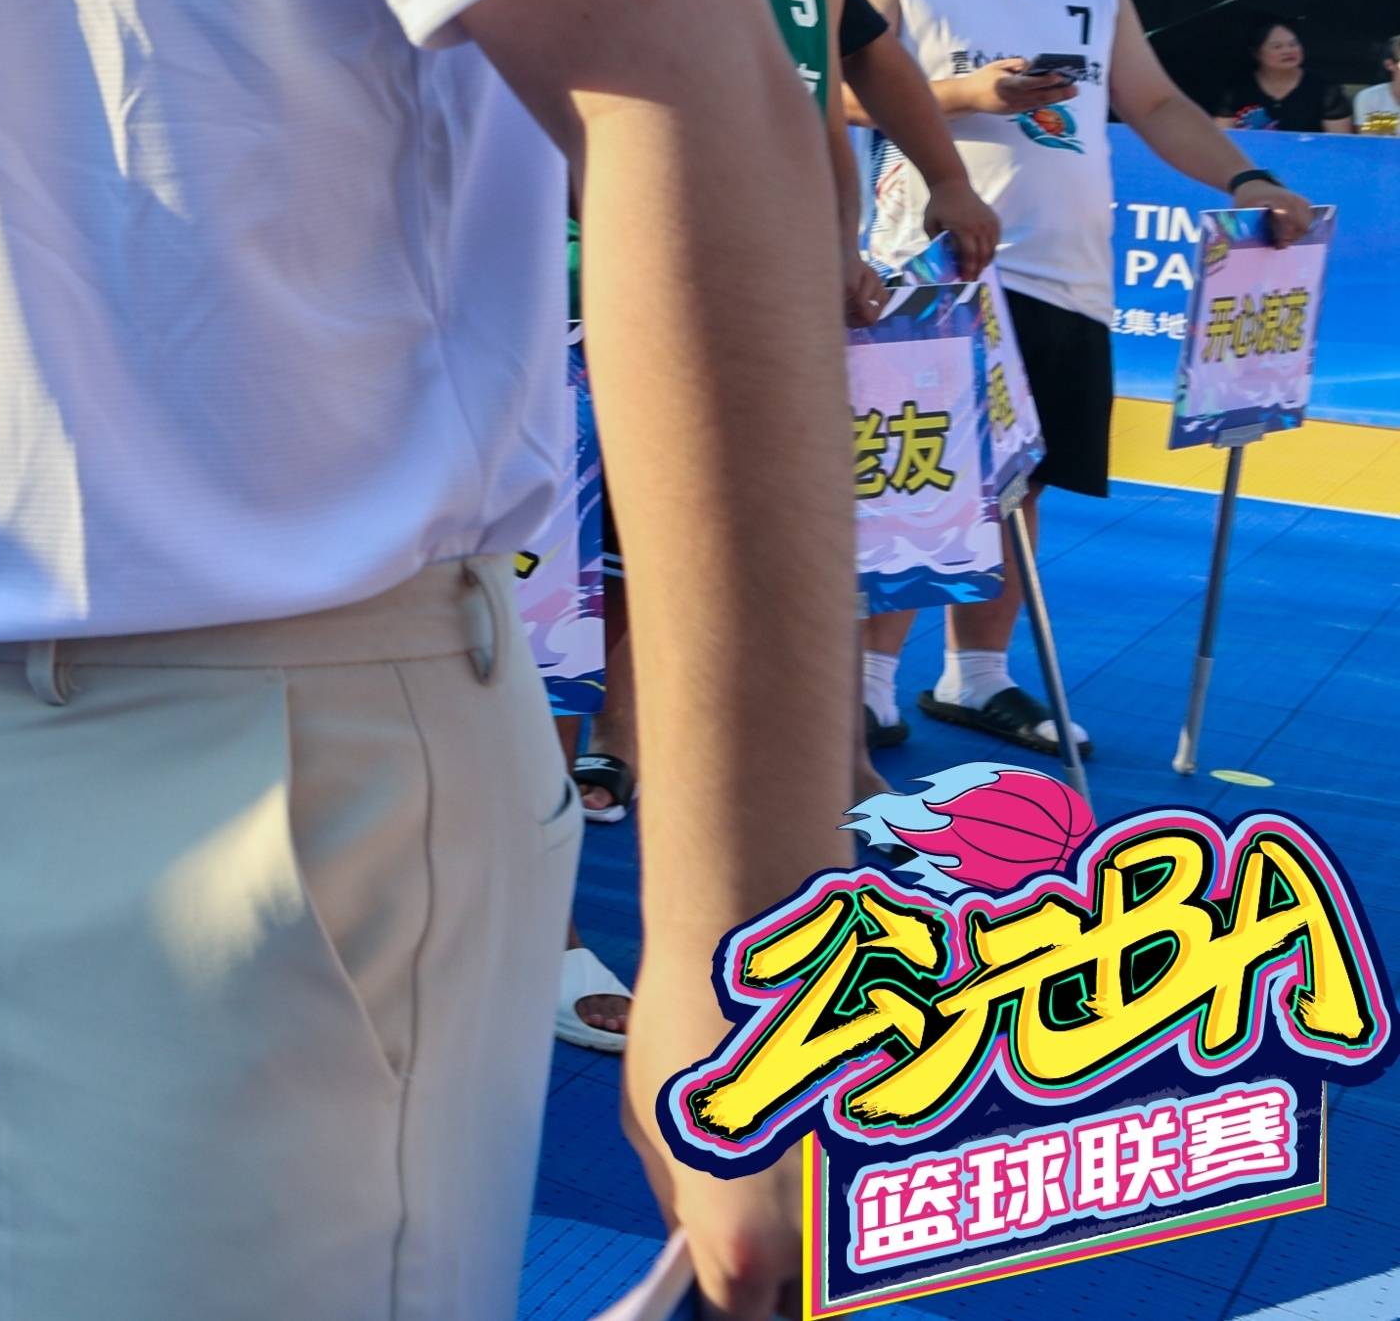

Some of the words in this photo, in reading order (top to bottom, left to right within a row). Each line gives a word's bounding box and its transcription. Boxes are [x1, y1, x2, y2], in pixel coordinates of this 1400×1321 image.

[1066, 5, 1091, 46] 7
[1124, 249, 1194, 291] PA
[1203, 288, 1309, 362] 开心浪花
